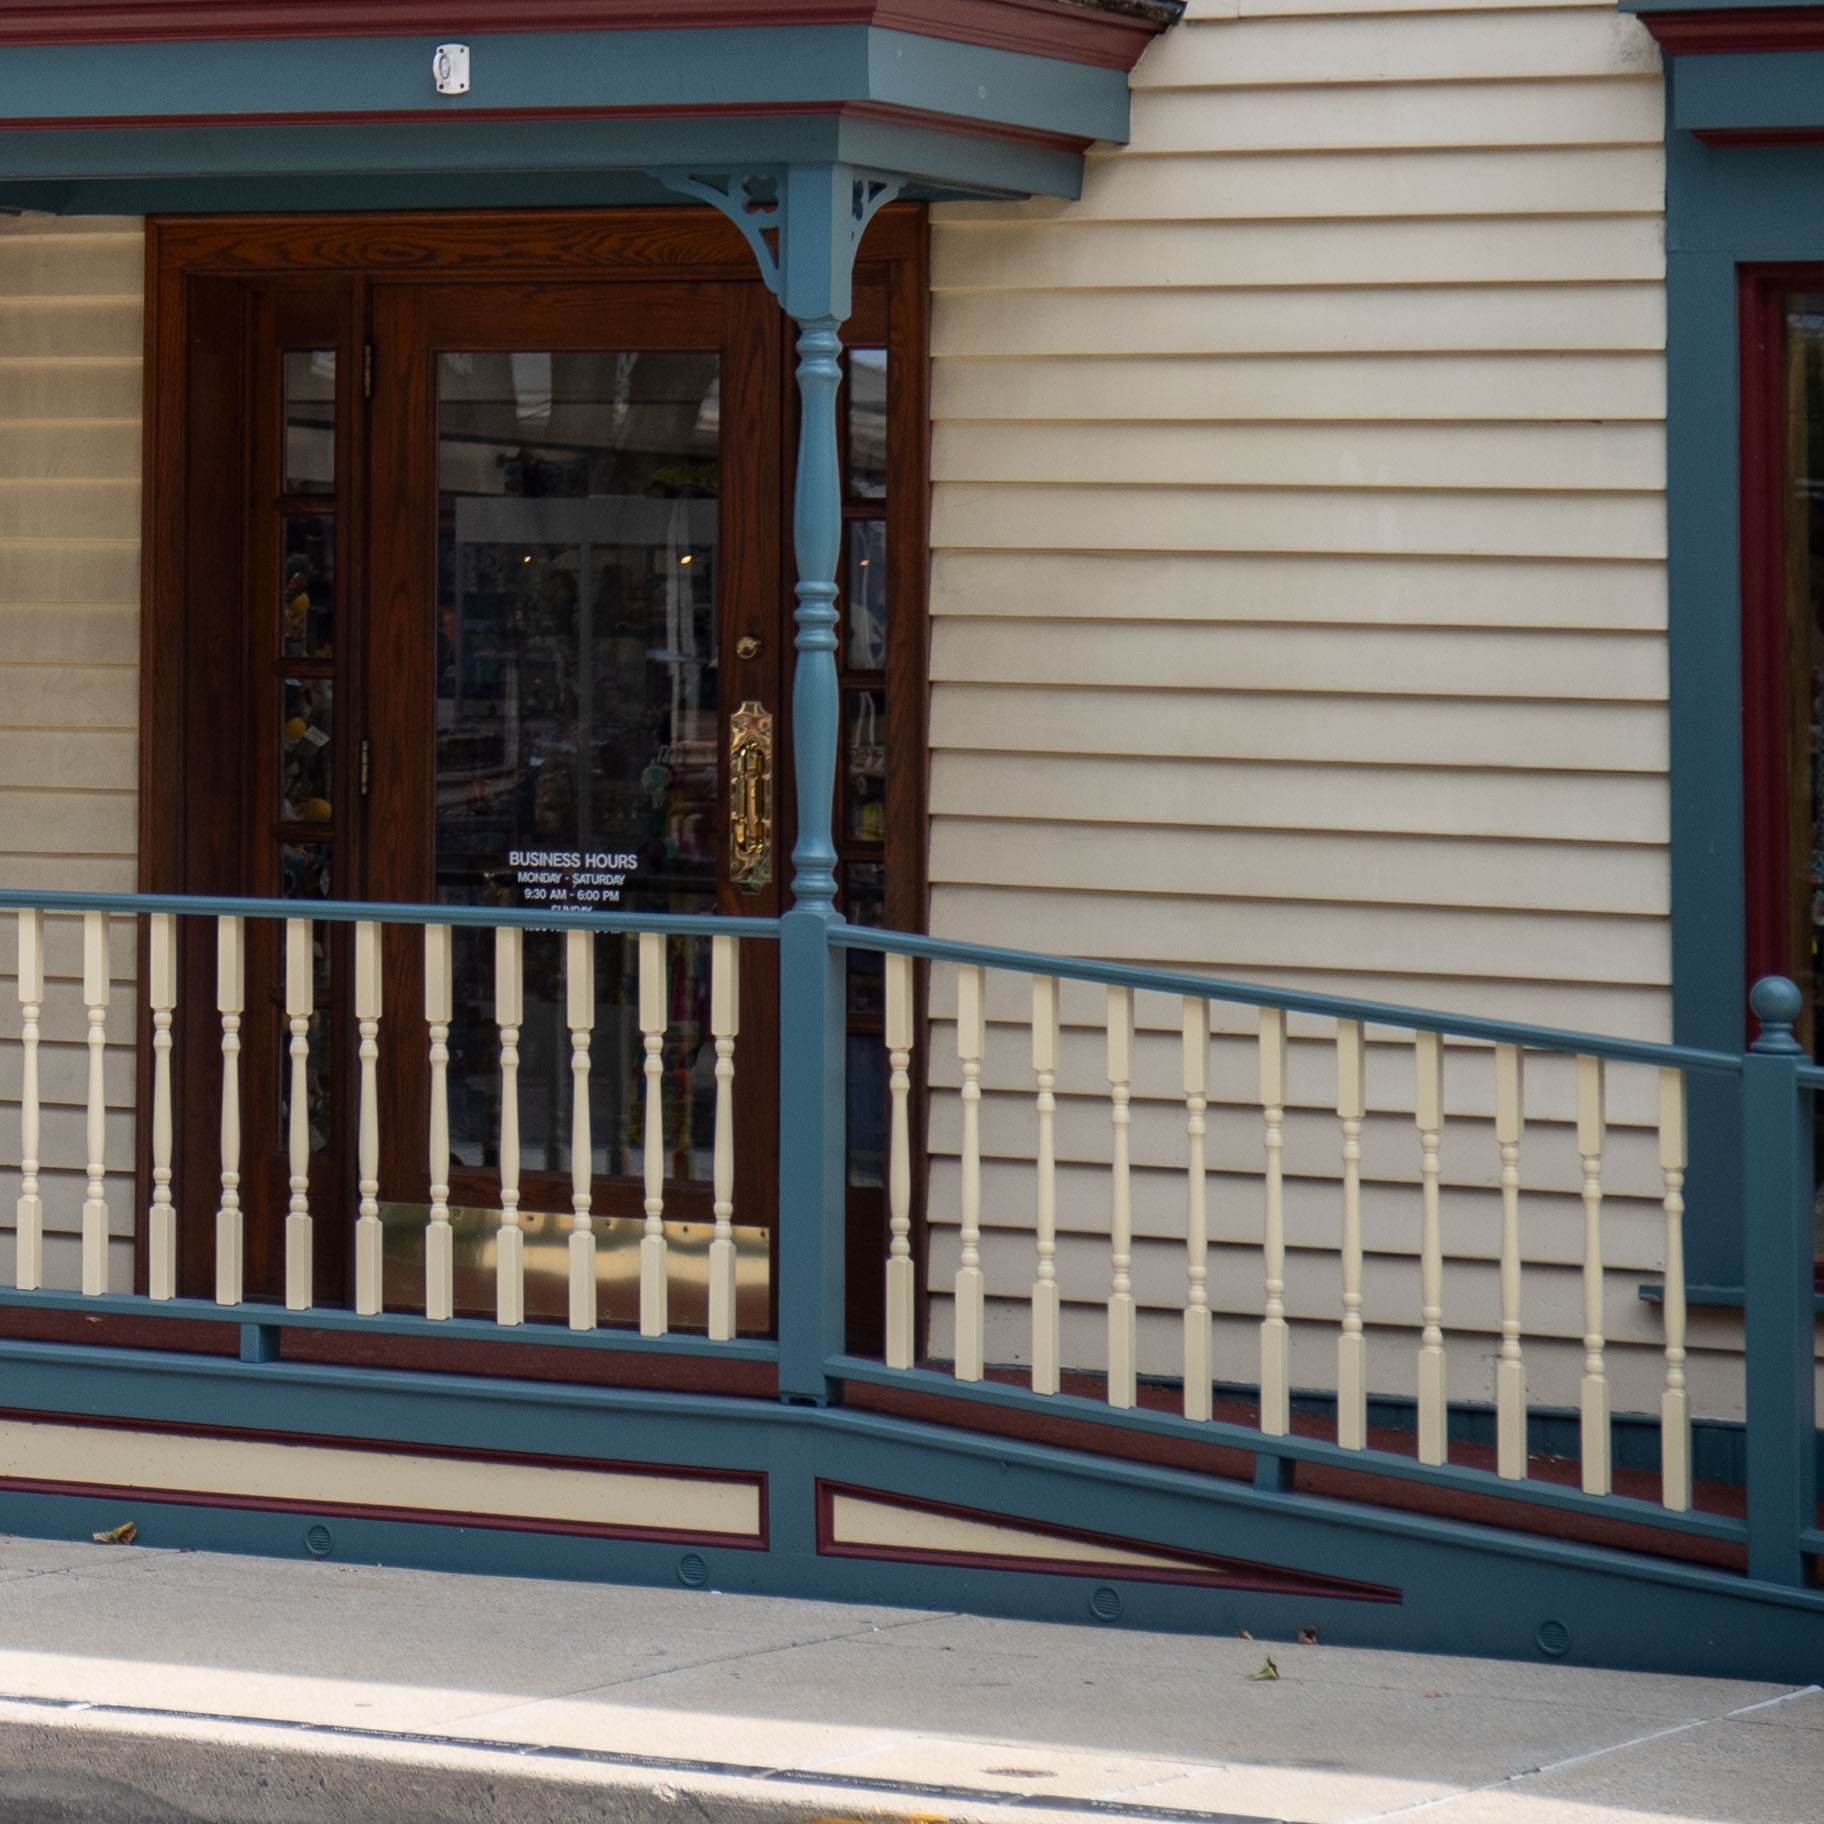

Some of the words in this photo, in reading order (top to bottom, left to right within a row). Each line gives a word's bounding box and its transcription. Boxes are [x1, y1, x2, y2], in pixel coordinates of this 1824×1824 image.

[509, 851, 581, 868] BUSINESS
[585, 853, 638, 870] HOURS
[517, 872, 562, 884] MONDAY
[572, 873, 626, 886] SATURDAY
[524, 888, 547, 900] 9:30
[549, 889, 567, 900] AM
[577, 890, 600, 901] 6:00
[602, 890, 620, 902] PM
